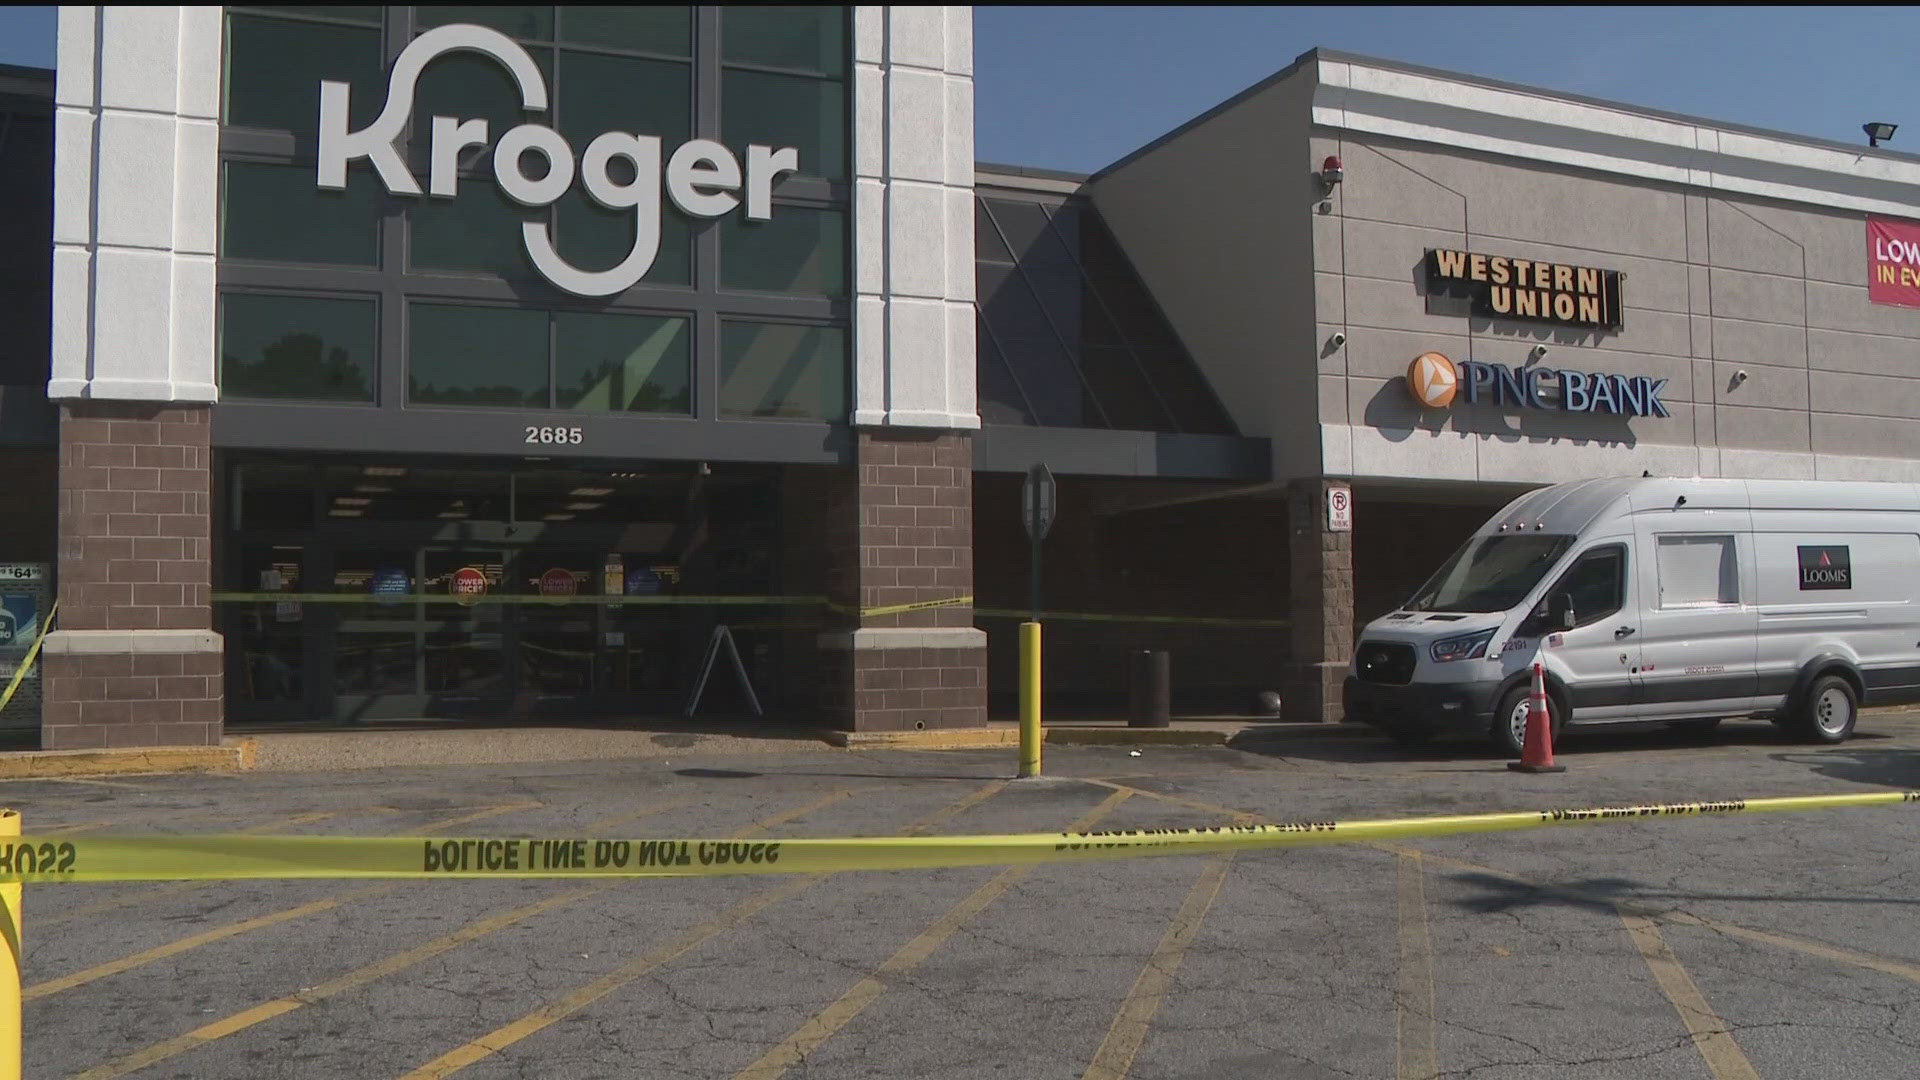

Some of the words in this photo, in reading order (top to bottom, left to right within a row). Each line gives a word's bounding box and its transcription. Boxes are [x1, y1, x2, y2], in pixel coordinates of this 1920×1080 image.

[316, 23, 799, 297] Kroger
[1434, 248, 1600, 294] WESTERN
[1877, 264, 1895, 285] IN
[1490, 286, 1600, 324] UNION
[1458, 360, 1557, 410] PNC
[1557, 369, 1671, 418] BANK
[525, 426, 583, 444] 2685
[1335, 511, 1344, 520] NO
[1803, 568, 1847, 582] LOOMIS
[1502, 640, 1527, 652] 22191
